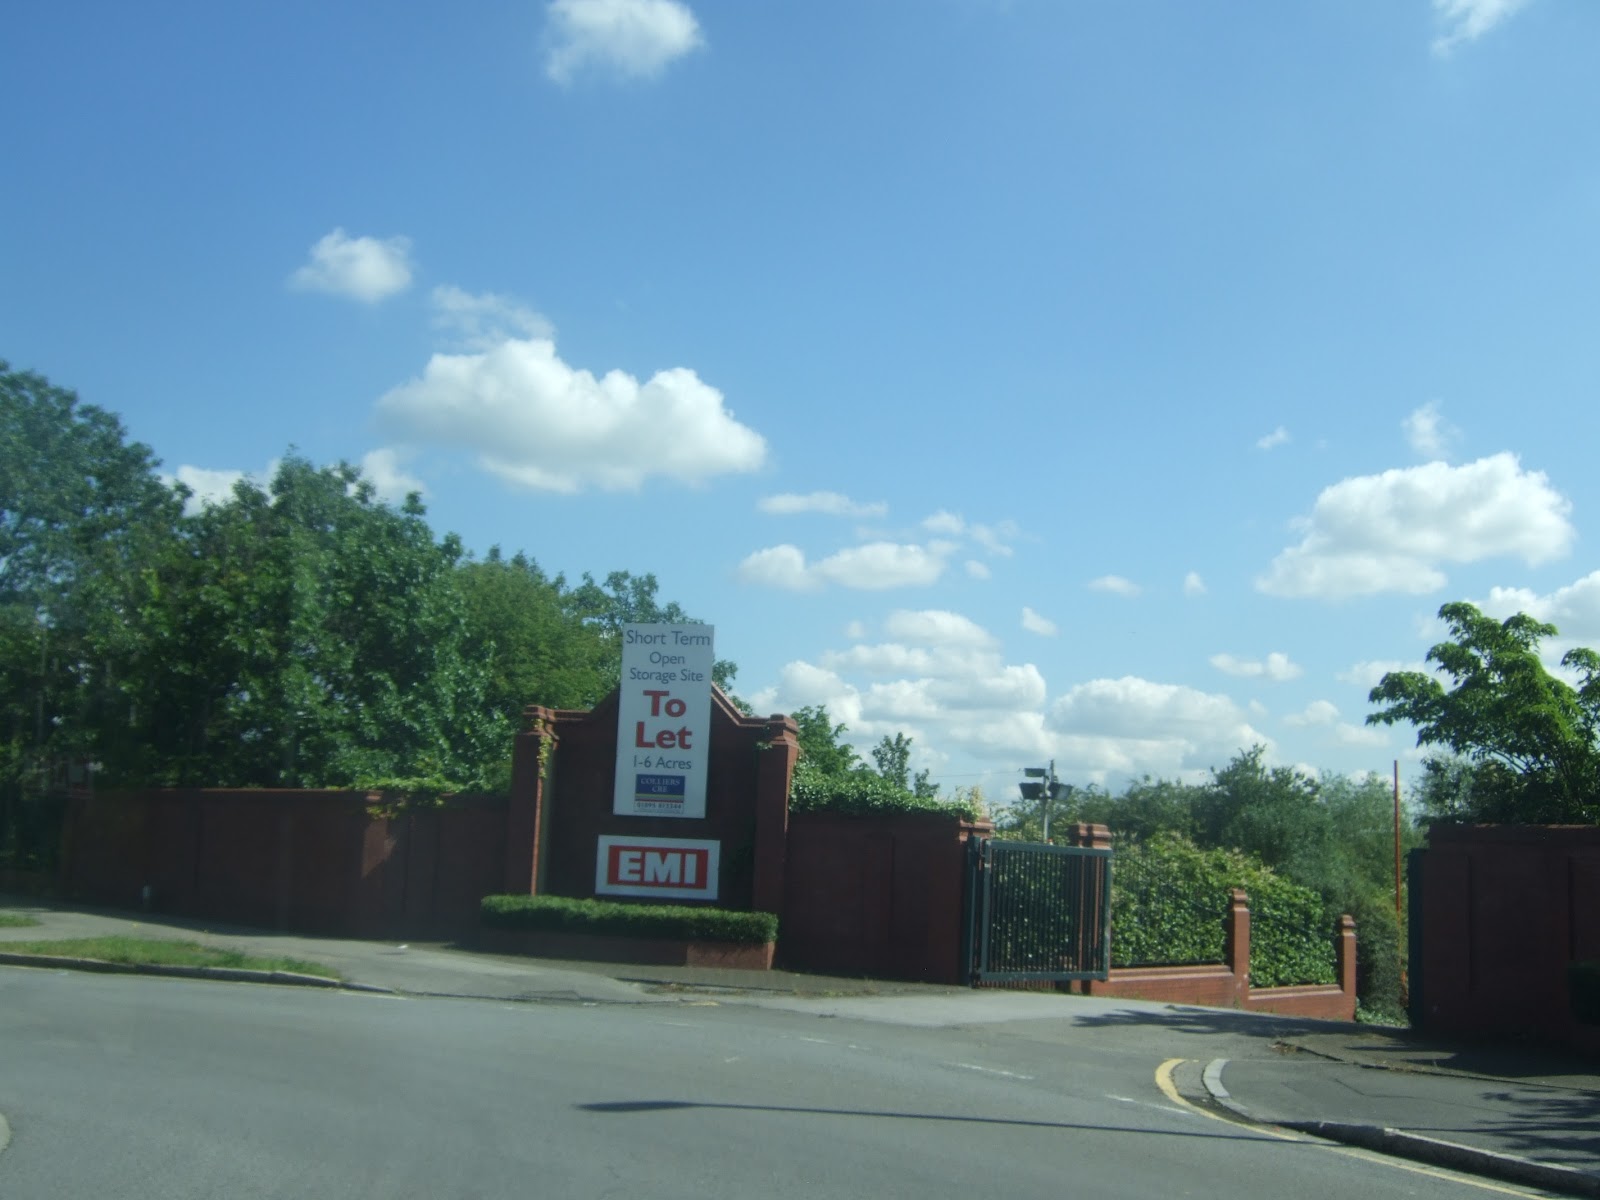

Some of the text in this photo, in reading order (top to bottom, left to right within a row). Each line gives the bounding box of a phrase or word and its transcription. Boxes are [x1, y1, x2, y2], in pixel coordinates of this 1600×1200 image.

[626, 629, 711, 646] Short Term
[649, 651, 685, 668] Open
[630, 667, 704, 685] Storage Site
[643, 690, 687, 718] To
[635, 721, 693, 750] Let
[655, 756, 692, 770] Acres
[618, 850, 697, 885] EMI
